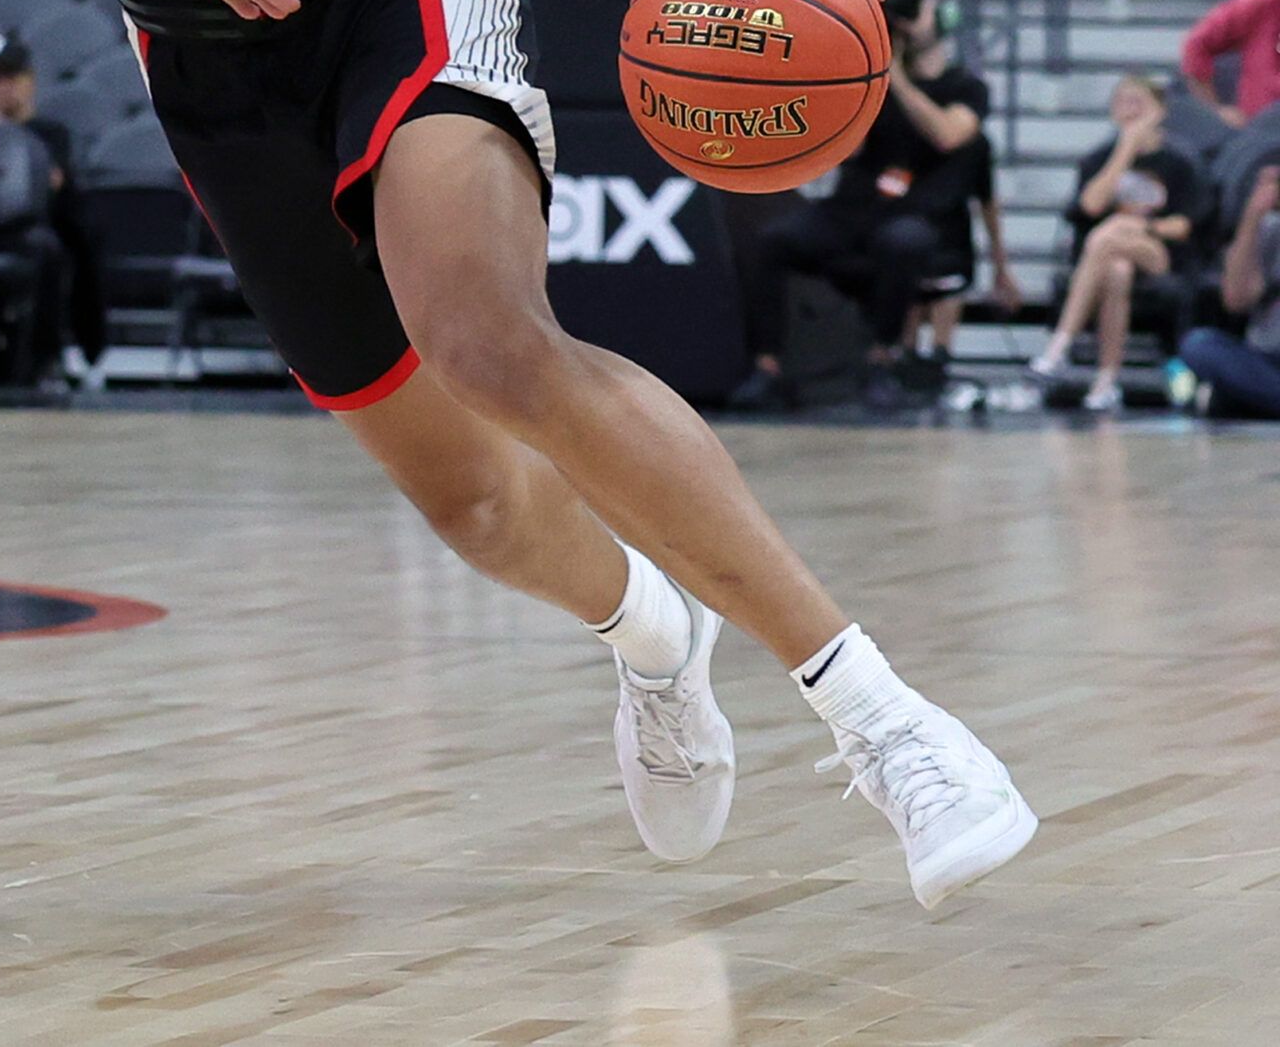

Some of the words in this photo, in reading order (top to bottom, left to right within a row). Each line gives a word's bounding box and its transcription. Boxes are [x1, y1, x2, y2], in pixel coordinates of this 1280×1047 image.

[661, 1, 748, 22] 1000
[646, 20, 795, 62] LEGACY
[639, 77, 811, 139] SPALDING
